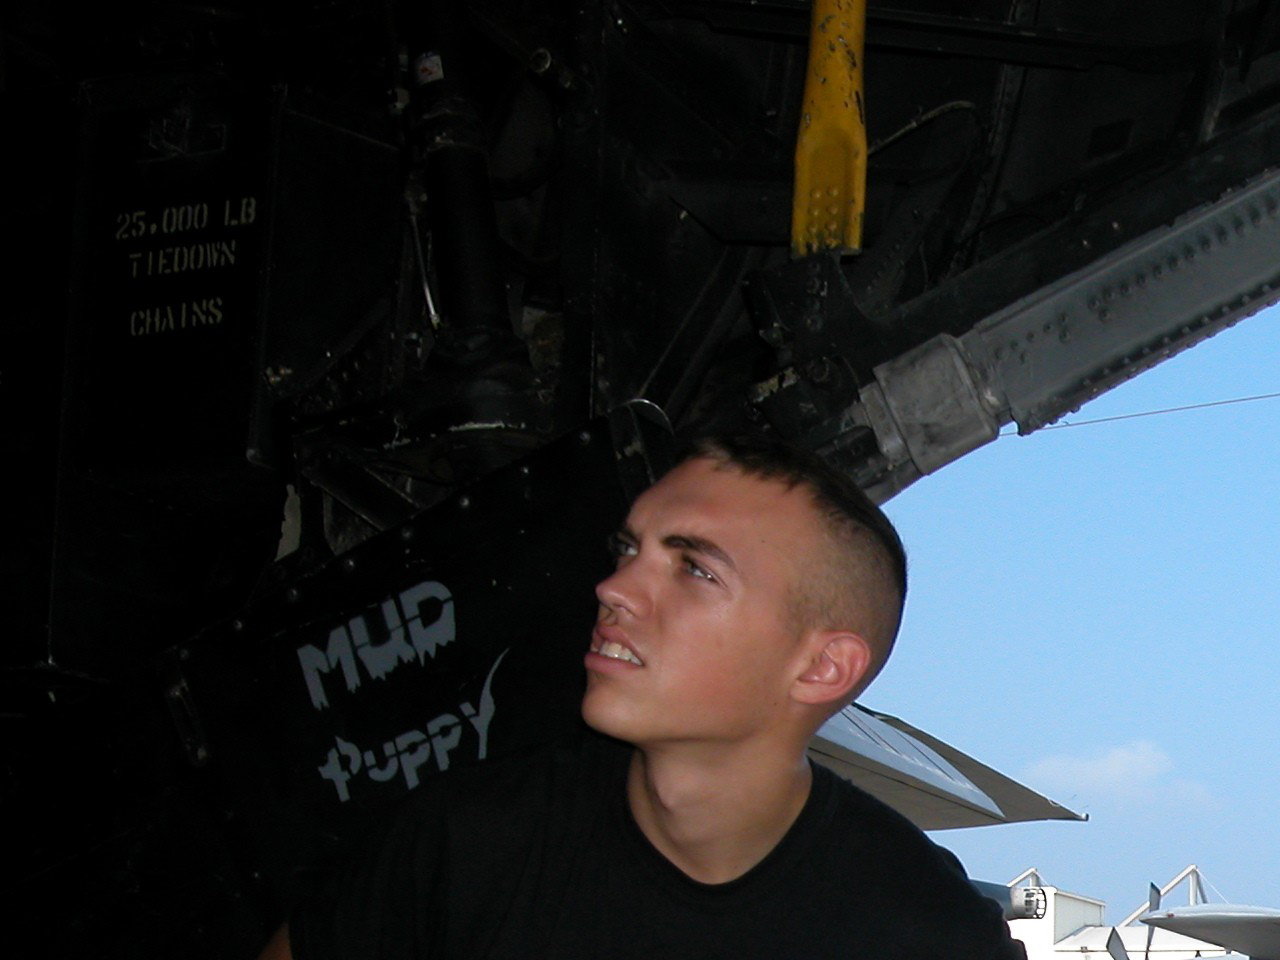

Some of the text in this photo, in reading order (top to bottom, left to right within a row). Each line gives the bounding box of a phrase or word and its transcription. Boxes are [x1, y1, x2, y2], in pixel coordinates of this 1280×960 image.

[224, 197, 257, 226] LB
[129, 239, 237, 279] TIEDOWN
[130, 296, 223, 336] CHAINS
[296, 580, 457, 712] MUD
